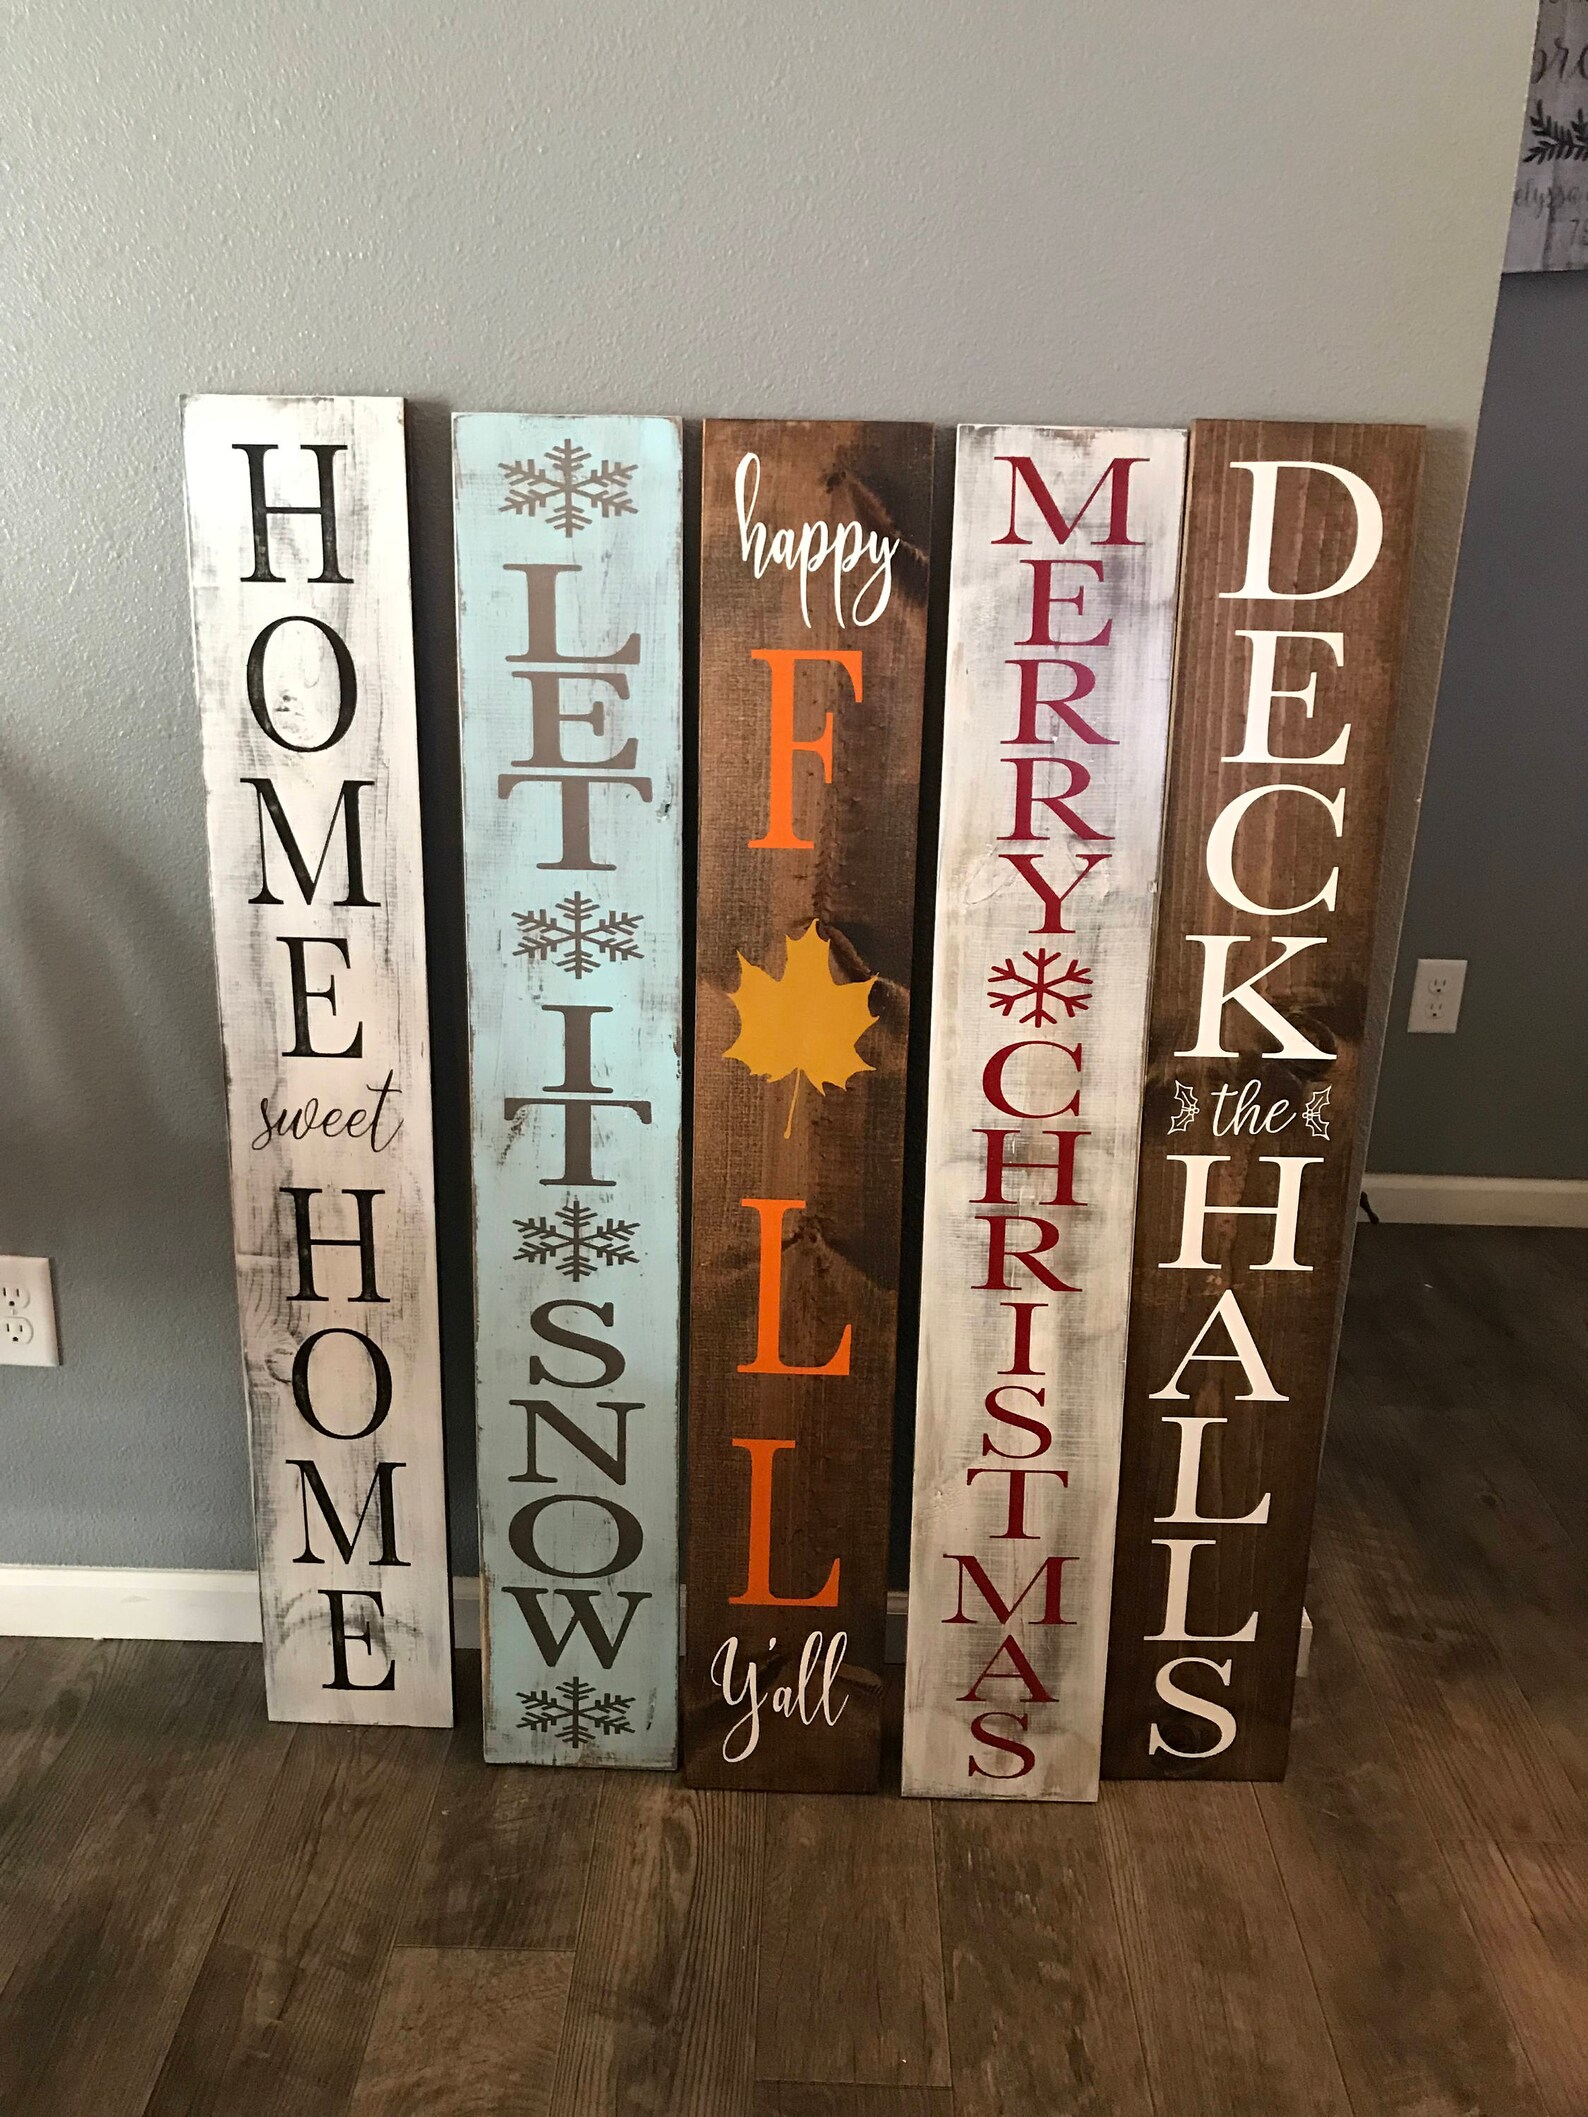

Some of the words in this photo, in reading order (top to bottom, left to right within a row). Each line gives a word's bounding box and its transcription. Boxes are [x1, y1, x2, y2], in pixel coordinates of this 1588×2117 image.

[499, 563, 653, 871] LET
[734, 452, 900, 629] happy
[990, 456, 1150, 935] MERRY
[231, 443, 381, 1059] HOME
[1172, 460, 1384, 1061] DECK
[251, 1069, 404, 1153] sweet
[503, 1004, 653, 1187] IT
[1210, 1079, 1297, 1137] the
[278, 1187, 412, 1691] HOME
[501, 1298, 653, 1670] SNOW
[940, 1040, 1092, 1780] CHRISTMAS
[1143, 1154, 1325, 1759] HALLS
[710, 1630, 849, 1764] Y'all
